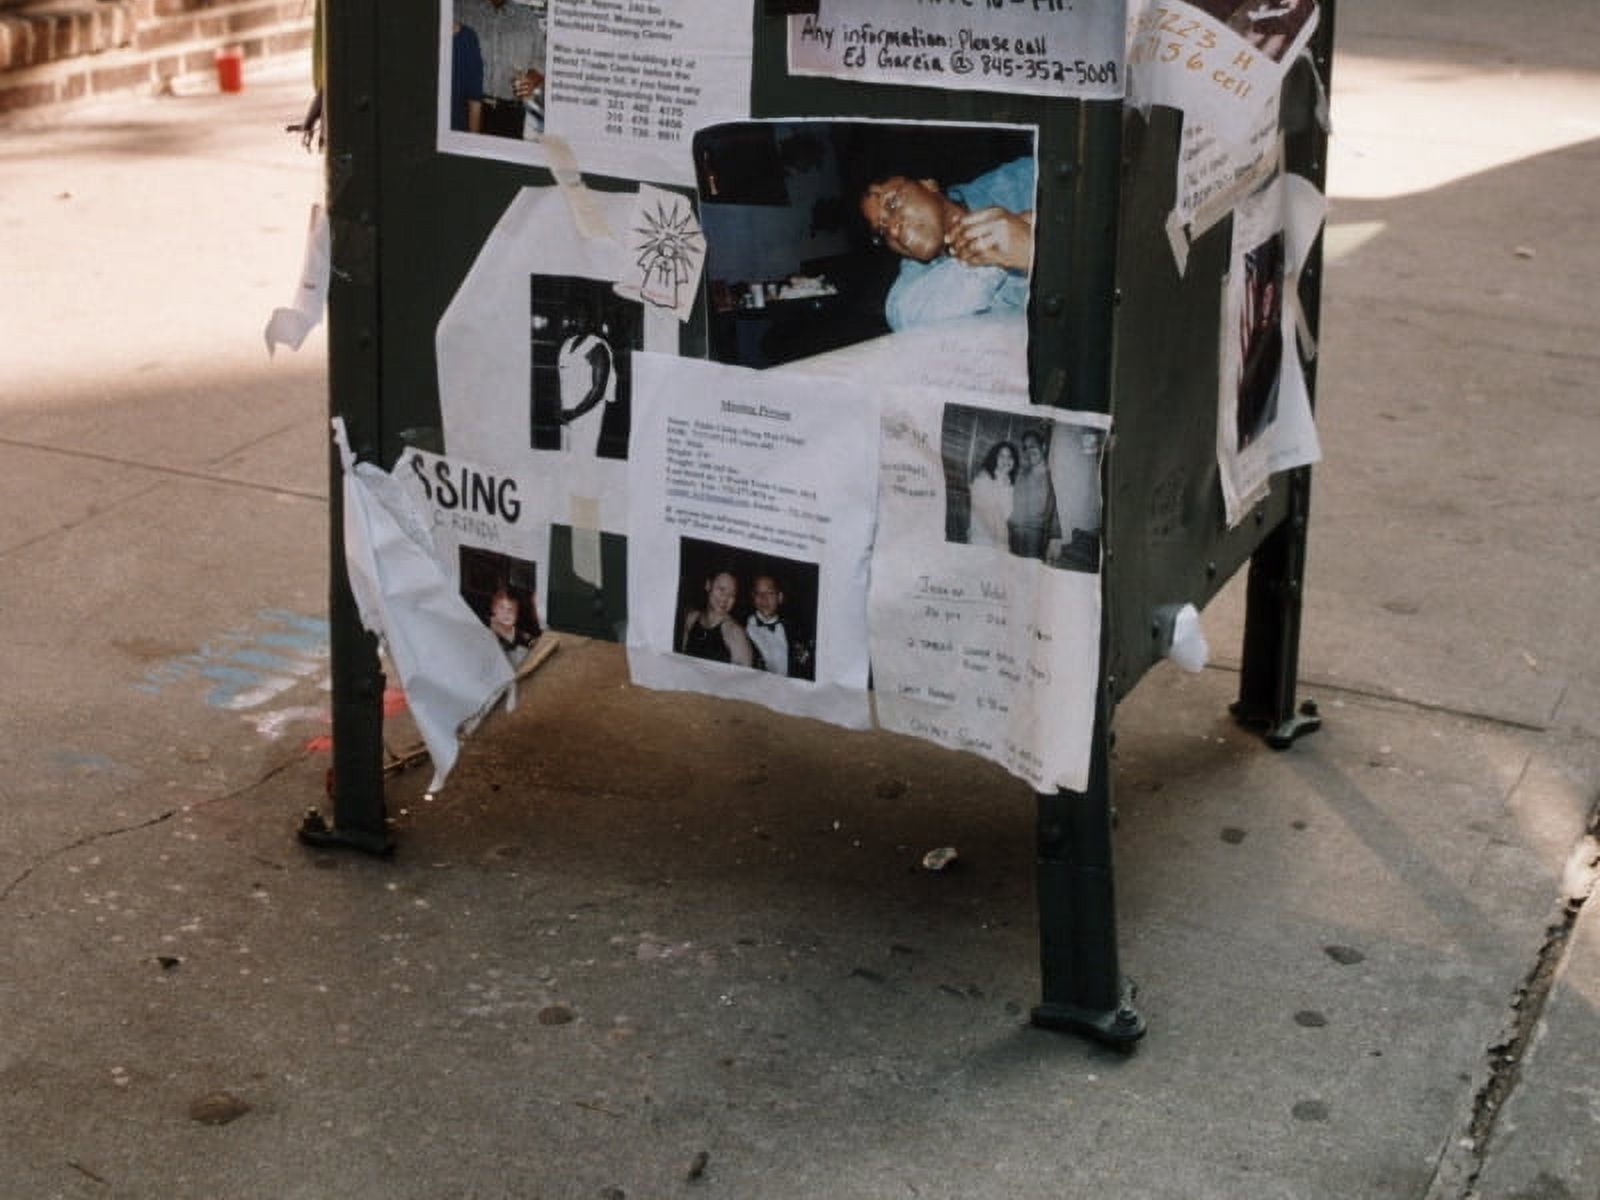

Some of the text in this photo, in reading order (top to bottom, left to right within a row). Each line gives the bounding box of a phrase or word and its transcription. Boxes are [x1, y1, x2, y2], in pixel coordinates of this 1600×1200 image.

[801, 15, 835, 50] Any
[957, 28, 1009, 51] Please
[1013, 35, 1047, 57] call
[842, 46, 866, 68] Ed
[876, 46, 945, 73] Garcia
[1211, 68, 1254, 98] cell
[411, 454, 521, 525] SSING
